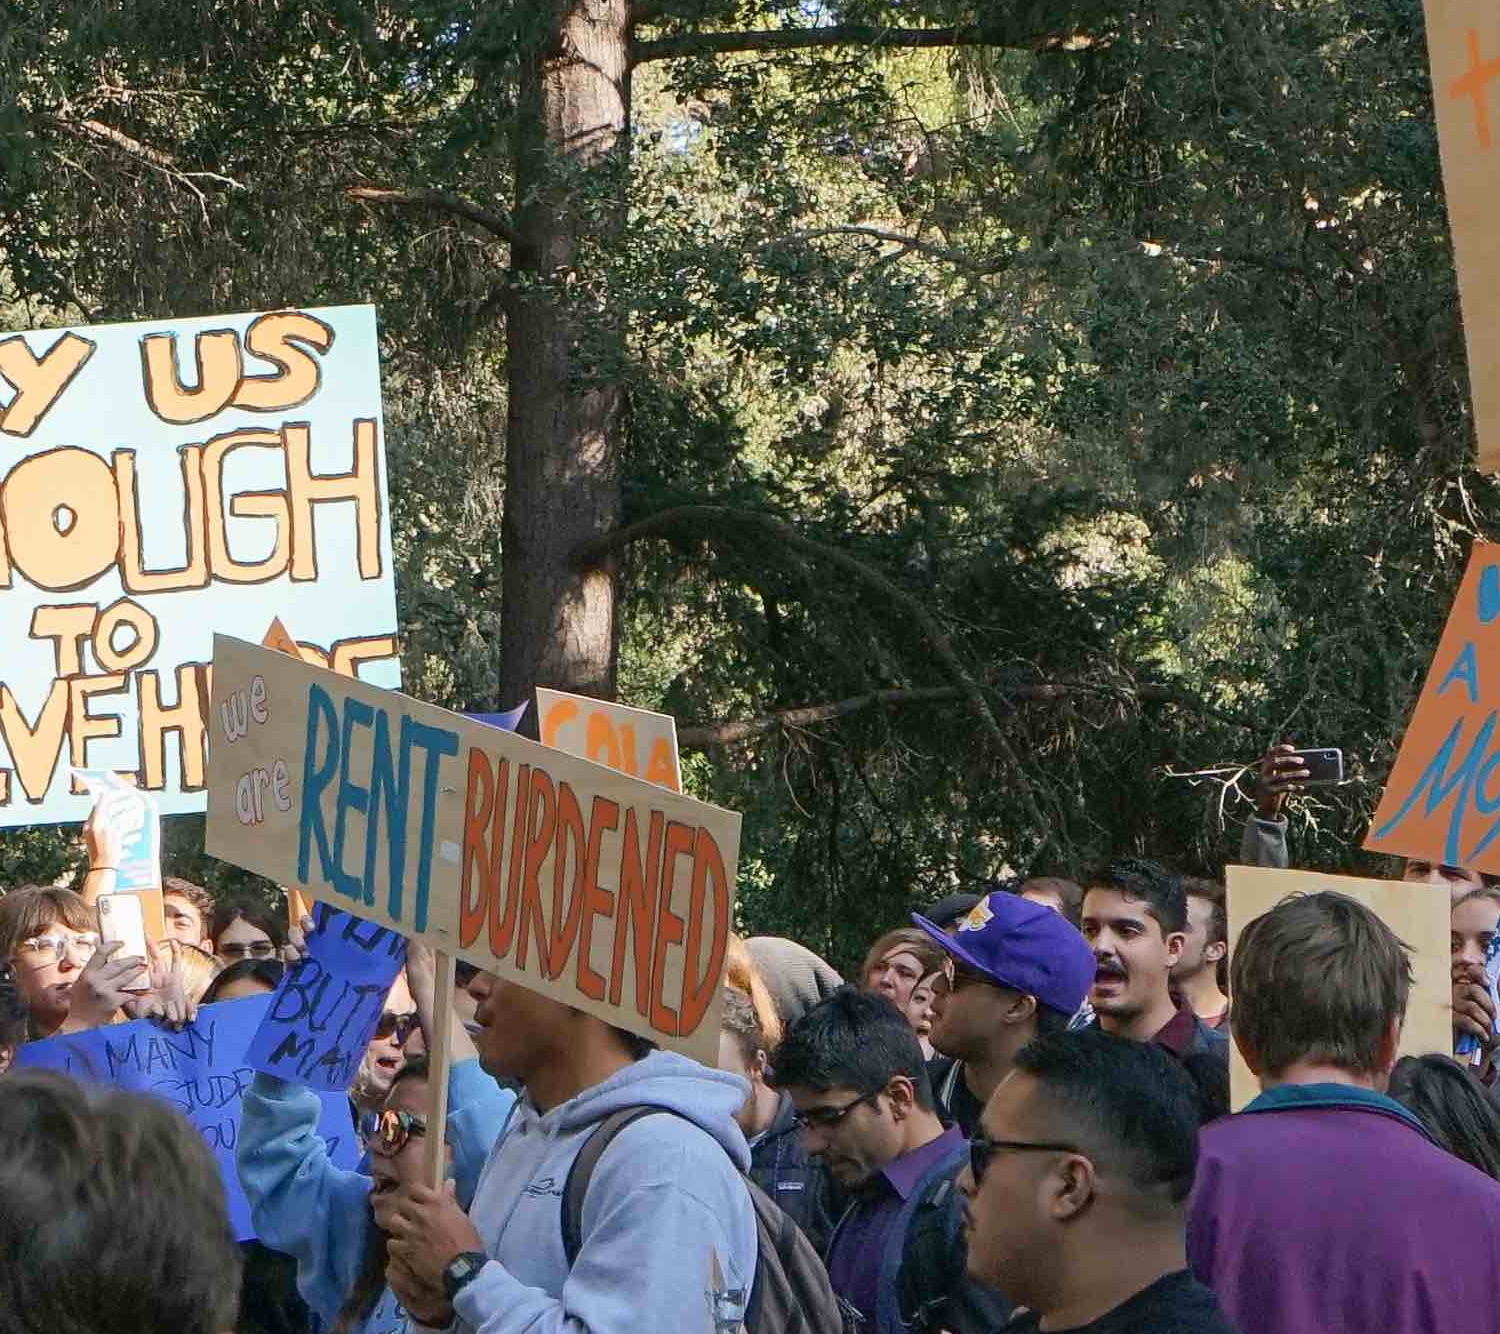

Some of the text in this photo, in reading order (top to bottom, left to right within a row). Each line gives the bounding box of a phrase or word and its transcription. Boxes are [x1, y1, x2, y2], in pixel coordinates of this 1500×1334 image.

[141, 312, 335, 425] US
[29, 597, 159, 678] TO
[1436, 641, 1480, 702] A
[219, 674, 269, 745] we
[233, 758, 293, 826] are
[297, 682, 460, 934] RENT
[459, 746, 730, 1039] BURDENED
[103, 1018, 217, 1079] MANY
